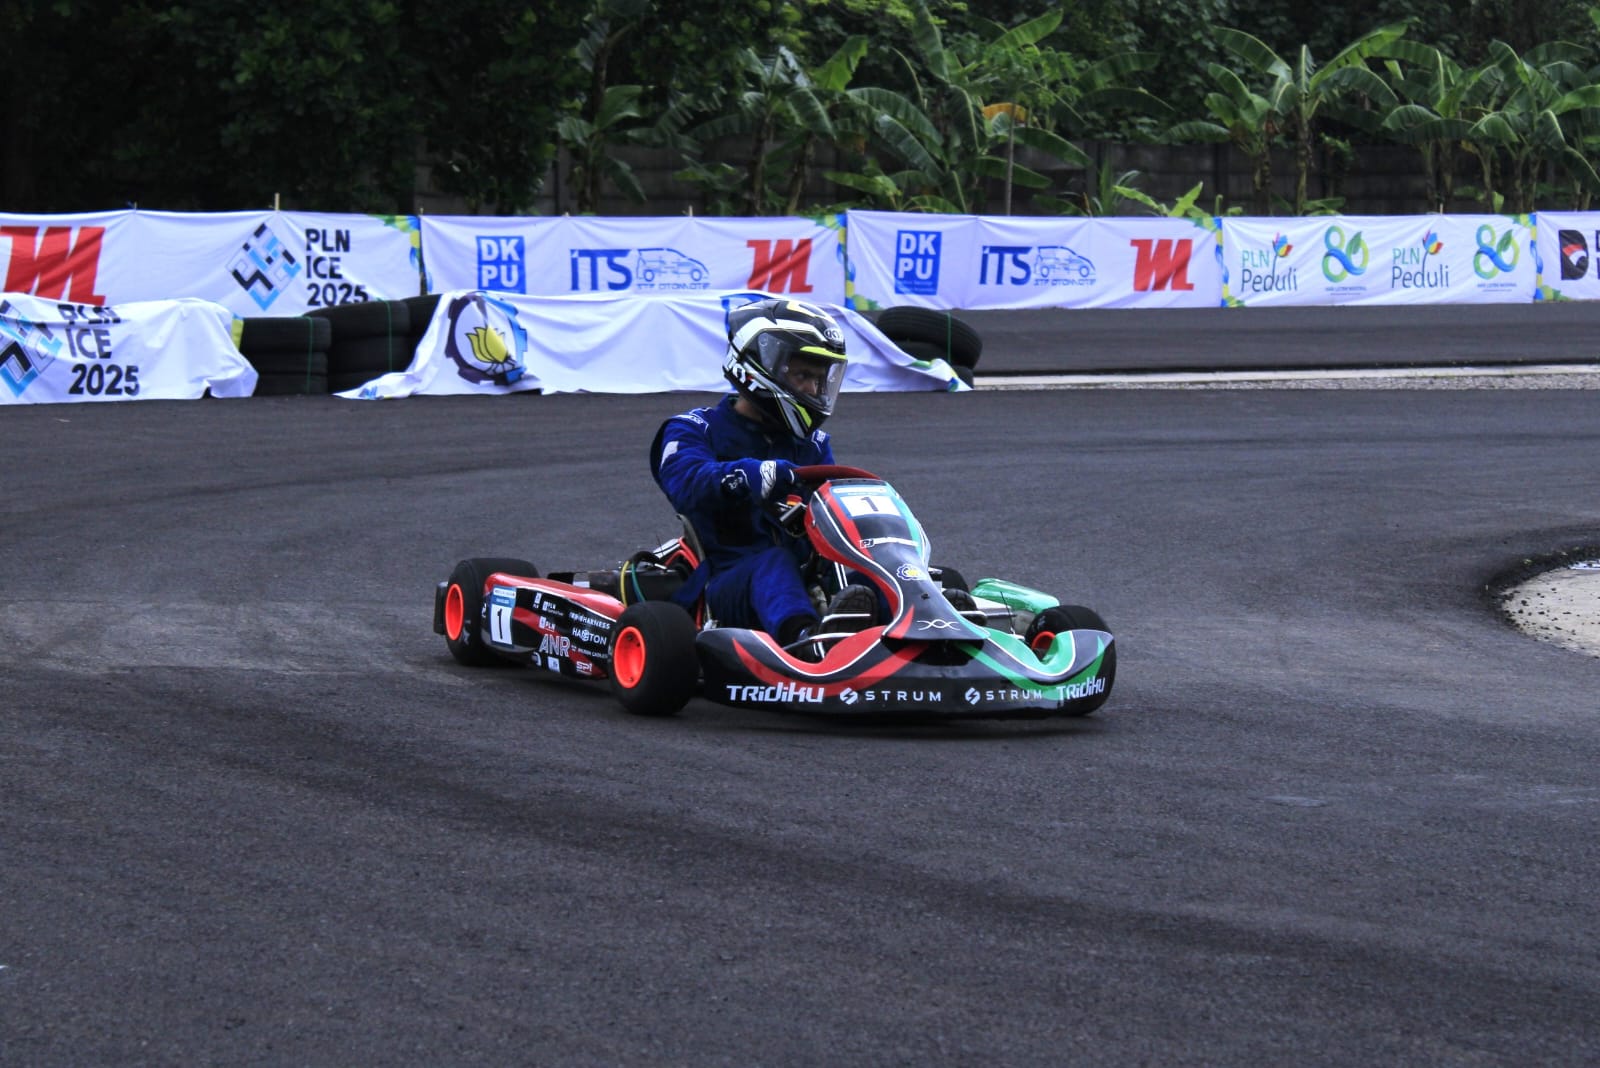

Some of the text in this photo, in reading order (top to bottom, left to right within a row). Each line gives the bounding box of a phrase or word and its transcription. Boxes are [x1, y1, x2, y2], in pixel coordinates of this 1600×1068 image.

[305, 228, 350, 252] PLN
[481, 239, 520, 261] DK
[900, 233, 937, 256] DK
[306, 255, 342, 279] ICE
[898, 257, 933, 280] PU
[1242, 250, 1269, 268] PLN
[1393, 248, 1420, 265] PLN
[481, 264, 519, 288] PU
[1241, 266, 1298, 292] Peduli
[1391, 264, 1450, 289] Peduli
[307, 282, 369, 307] 2025
[65, 327, 112, 359] ICE
[68, 363, 140, 396] 2025
[860, 496, 879, 512] 1
[497, 608, 503, 640] 1
[583, 615, 611, 631] HARNESS
[539, 633, 571, 657] ANR
[865, 690, 942, 701] STRUM
[985, 689, 1043, 700] STRUM
